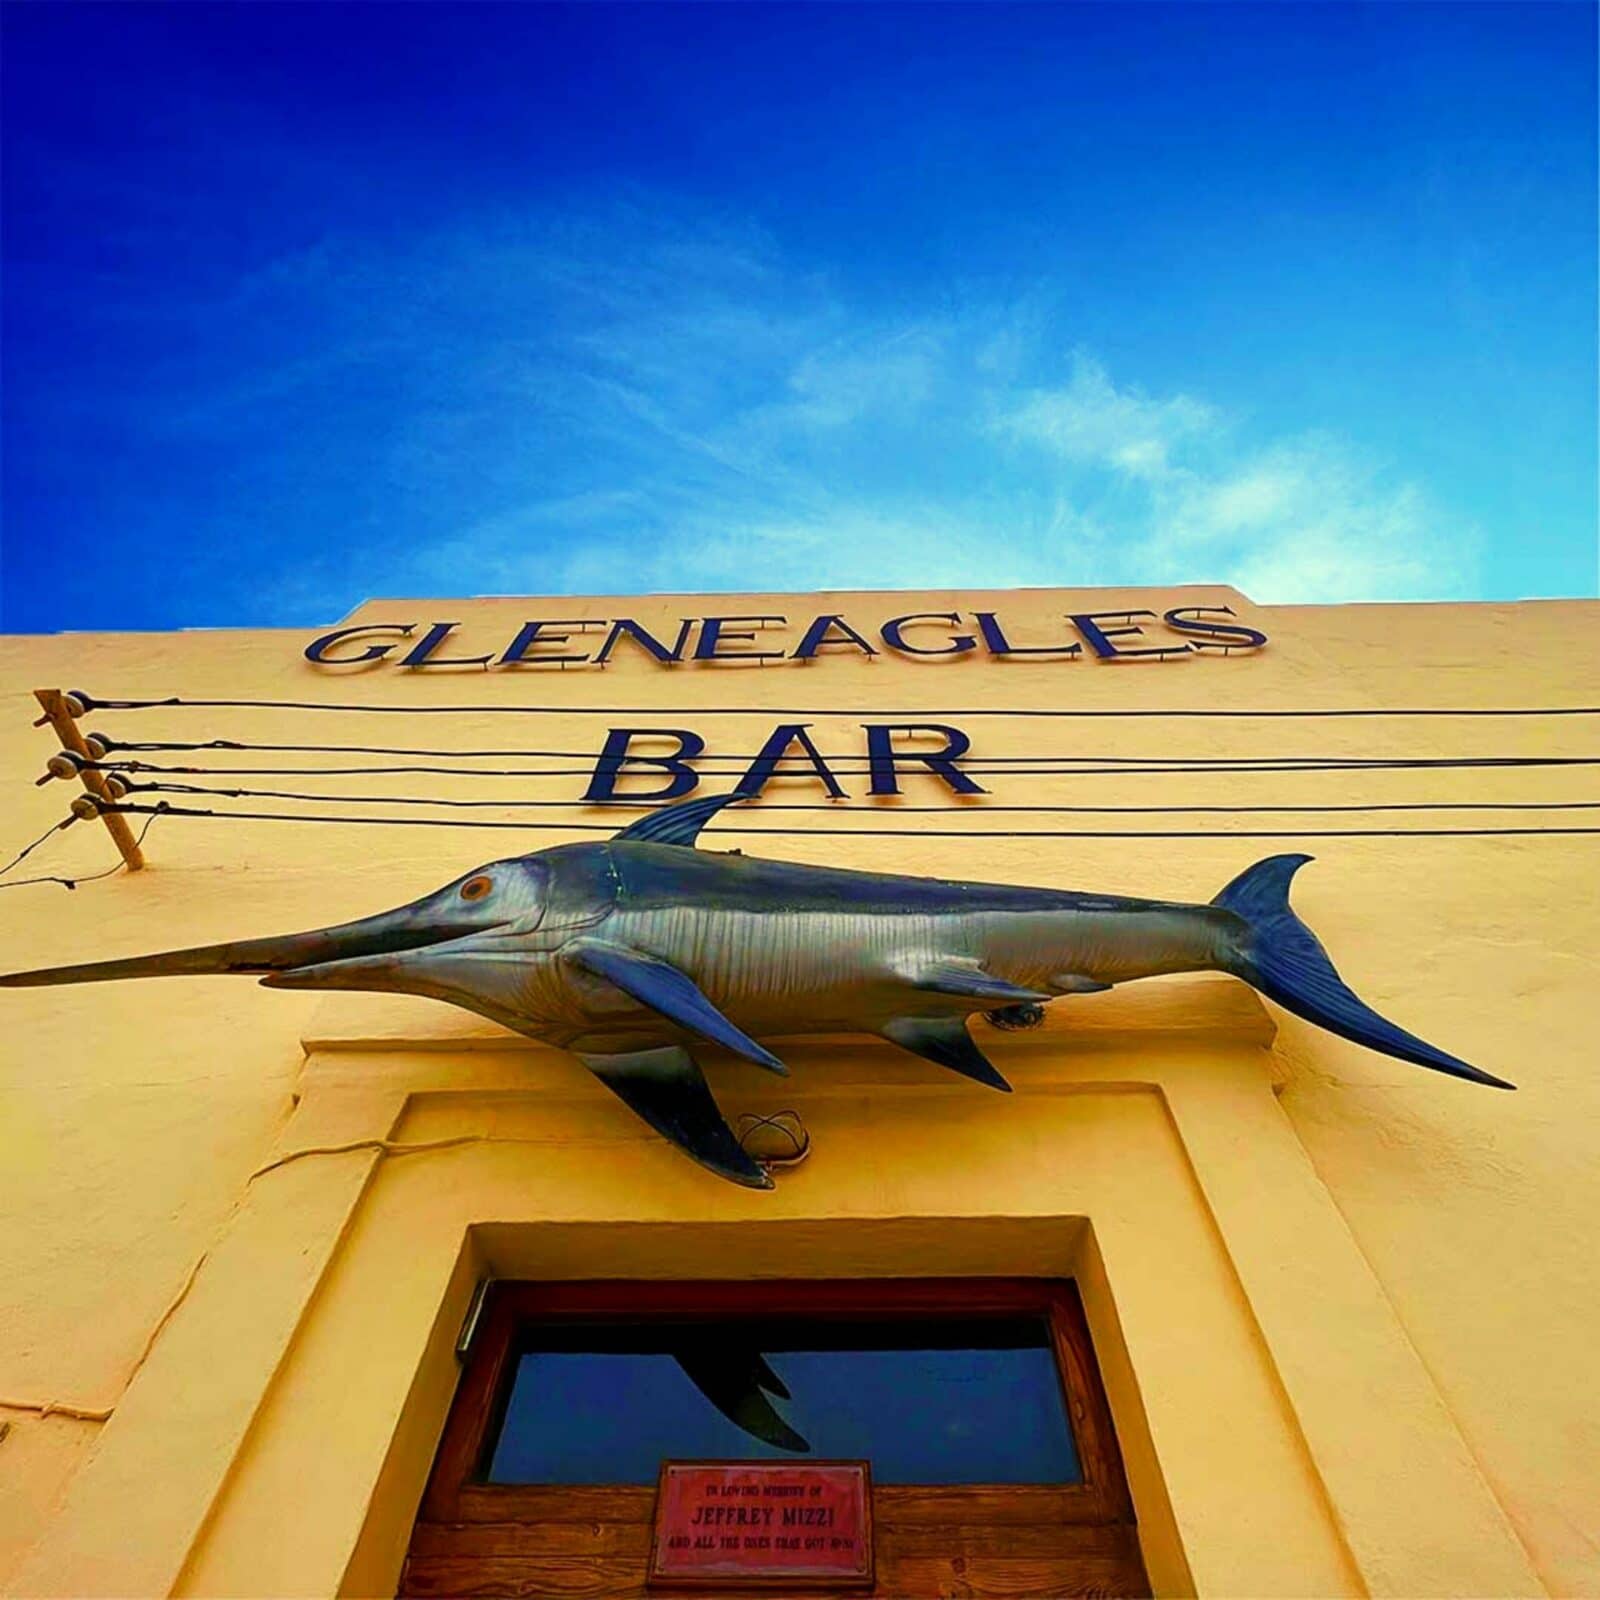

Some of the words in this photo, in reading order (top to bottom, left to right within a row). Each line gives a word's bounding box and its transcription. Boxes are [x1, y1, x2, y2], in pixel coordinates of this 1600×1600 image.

[303, 605, 1268, 668] GLENEAGLES
[580, 723, 991, 802] BAR
[691, 1506, 774, 1526] JEFFREY
[783, 1507, 834, 1527] MIZZI
[694, 1536, 715, 1549] ALL
